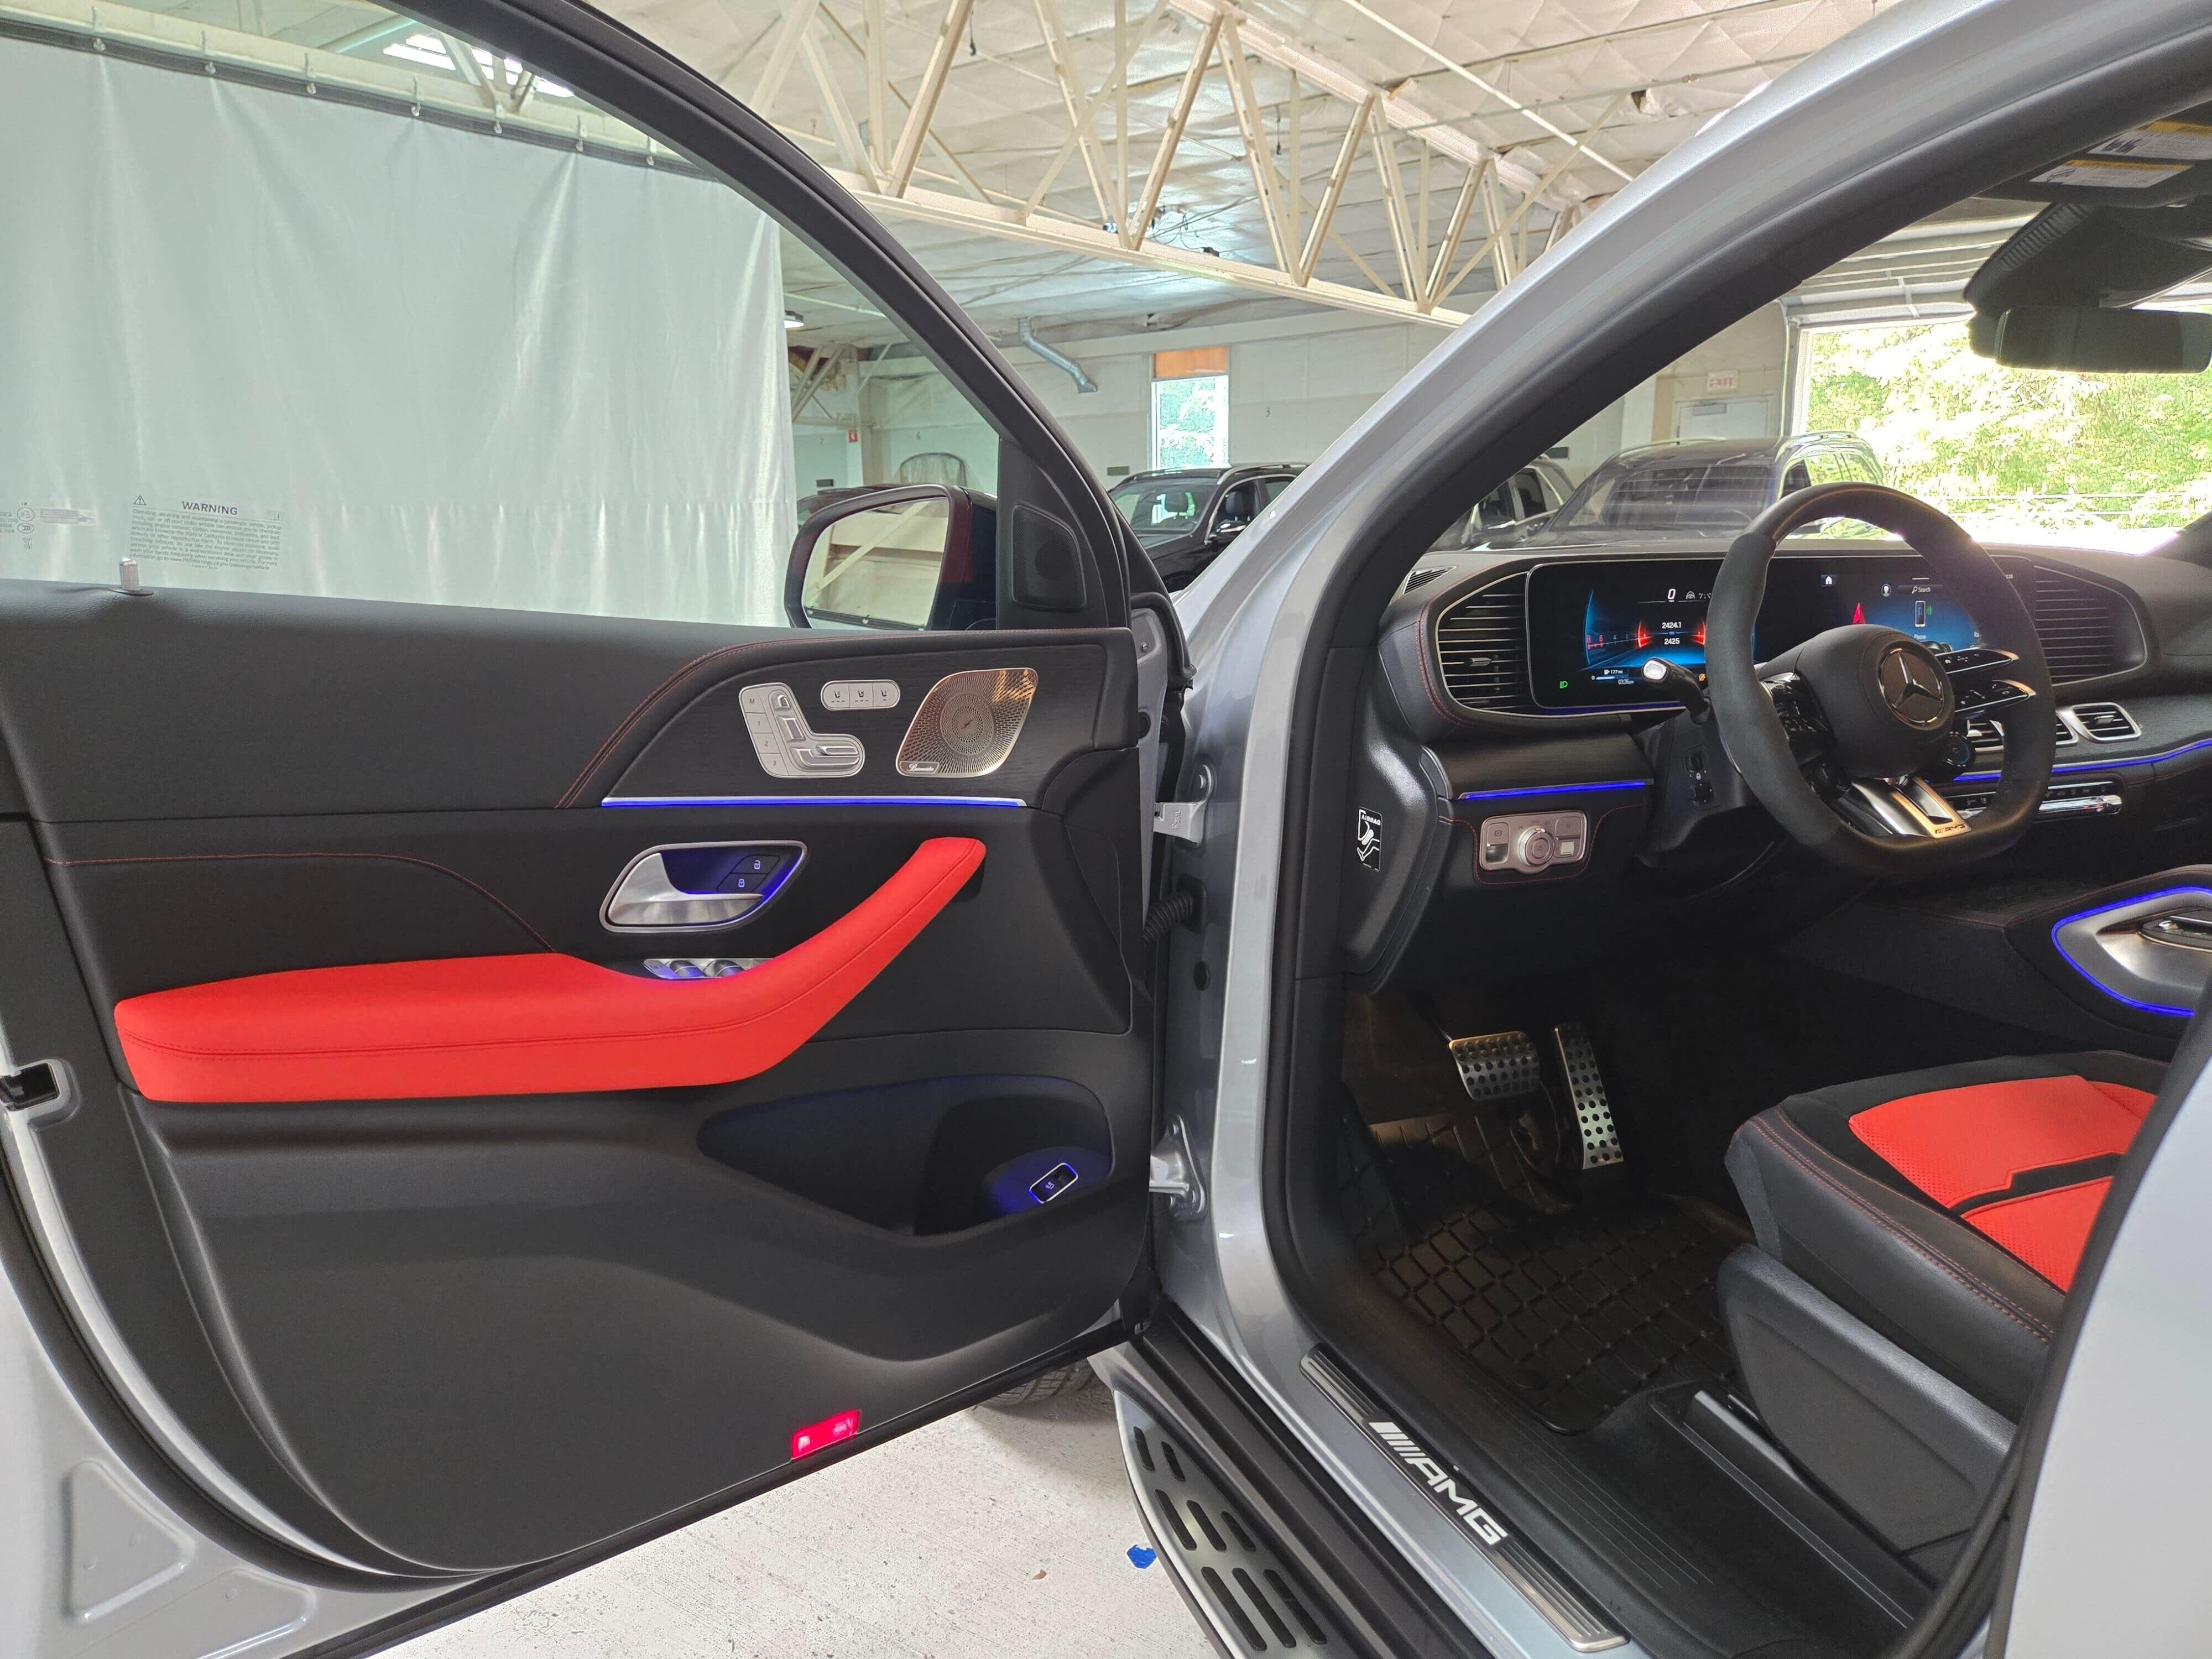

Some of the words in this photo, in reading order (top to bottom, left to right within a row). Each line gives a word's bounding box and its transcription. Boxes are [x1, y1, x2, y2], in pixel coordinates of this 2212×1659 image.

[182, 500, 237, 515] WARNING
[1667, 588, 1676, 599] 0
[1361, 814, 1381, 826] AIRBAG
